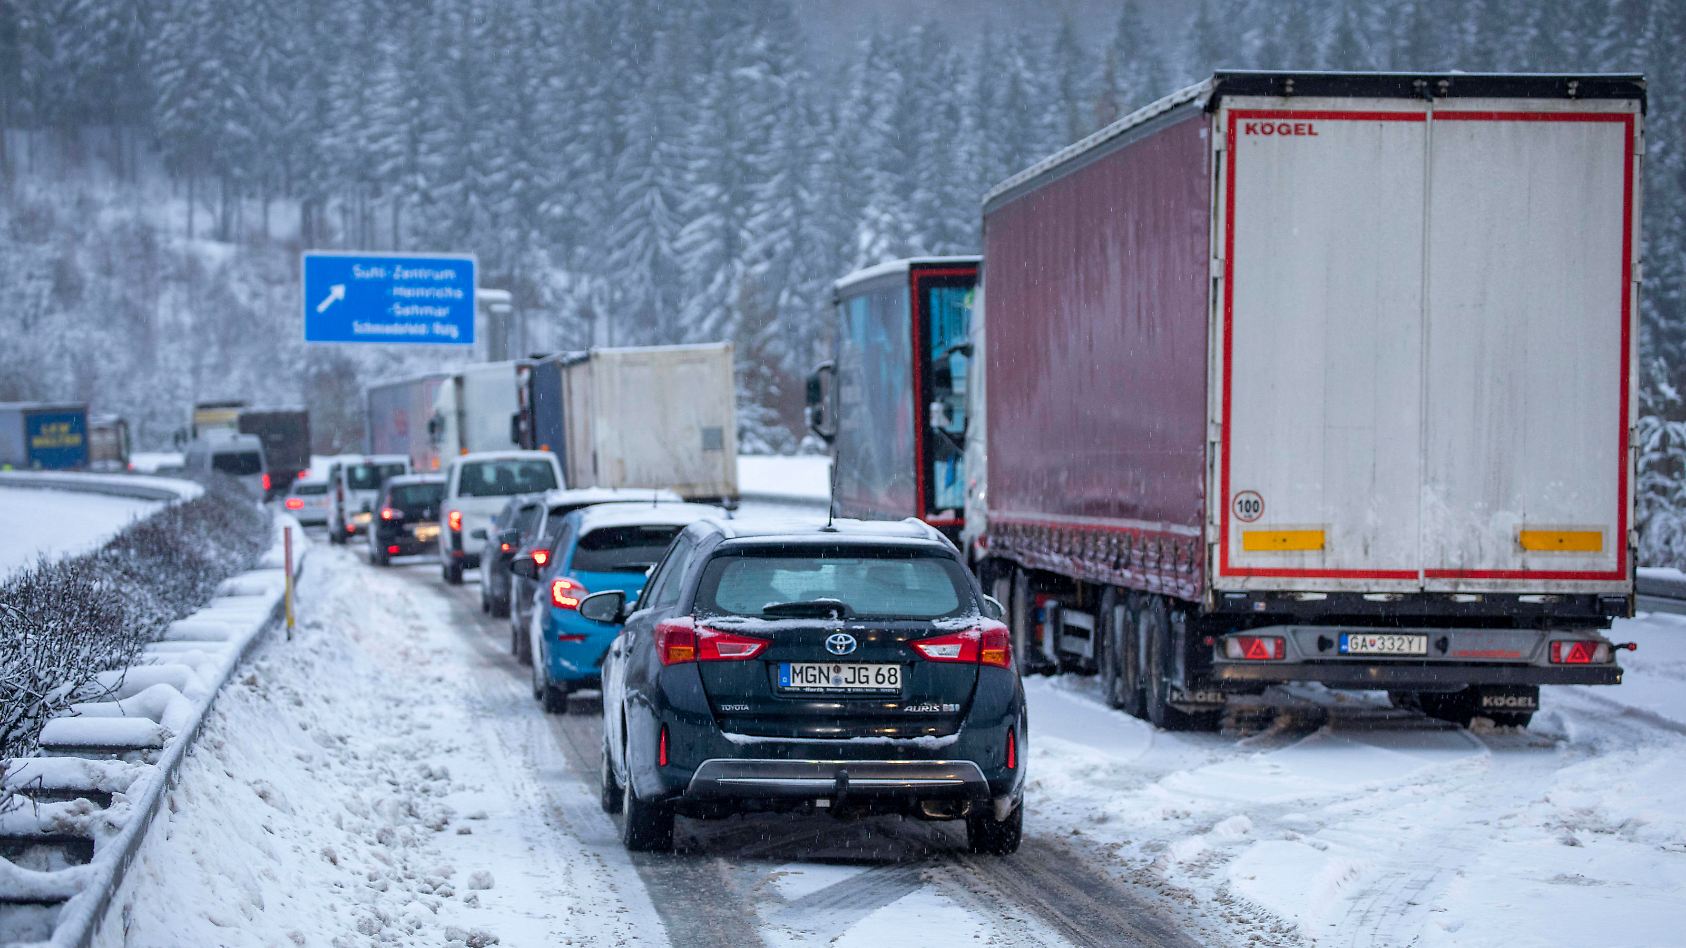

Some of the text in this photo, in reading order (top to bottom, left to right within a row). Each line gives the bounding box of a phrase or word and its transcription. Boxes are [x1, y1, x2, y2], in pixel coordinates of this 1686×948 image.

[1245, 121, 1319, 136] KÖGEL
[1237, 499, 1260, 513] 100
[1349, 636, 1369, 651] GA
[791, 665, 898, 685] MGN JG 68
[903, 704, 940, 712] AURIS
